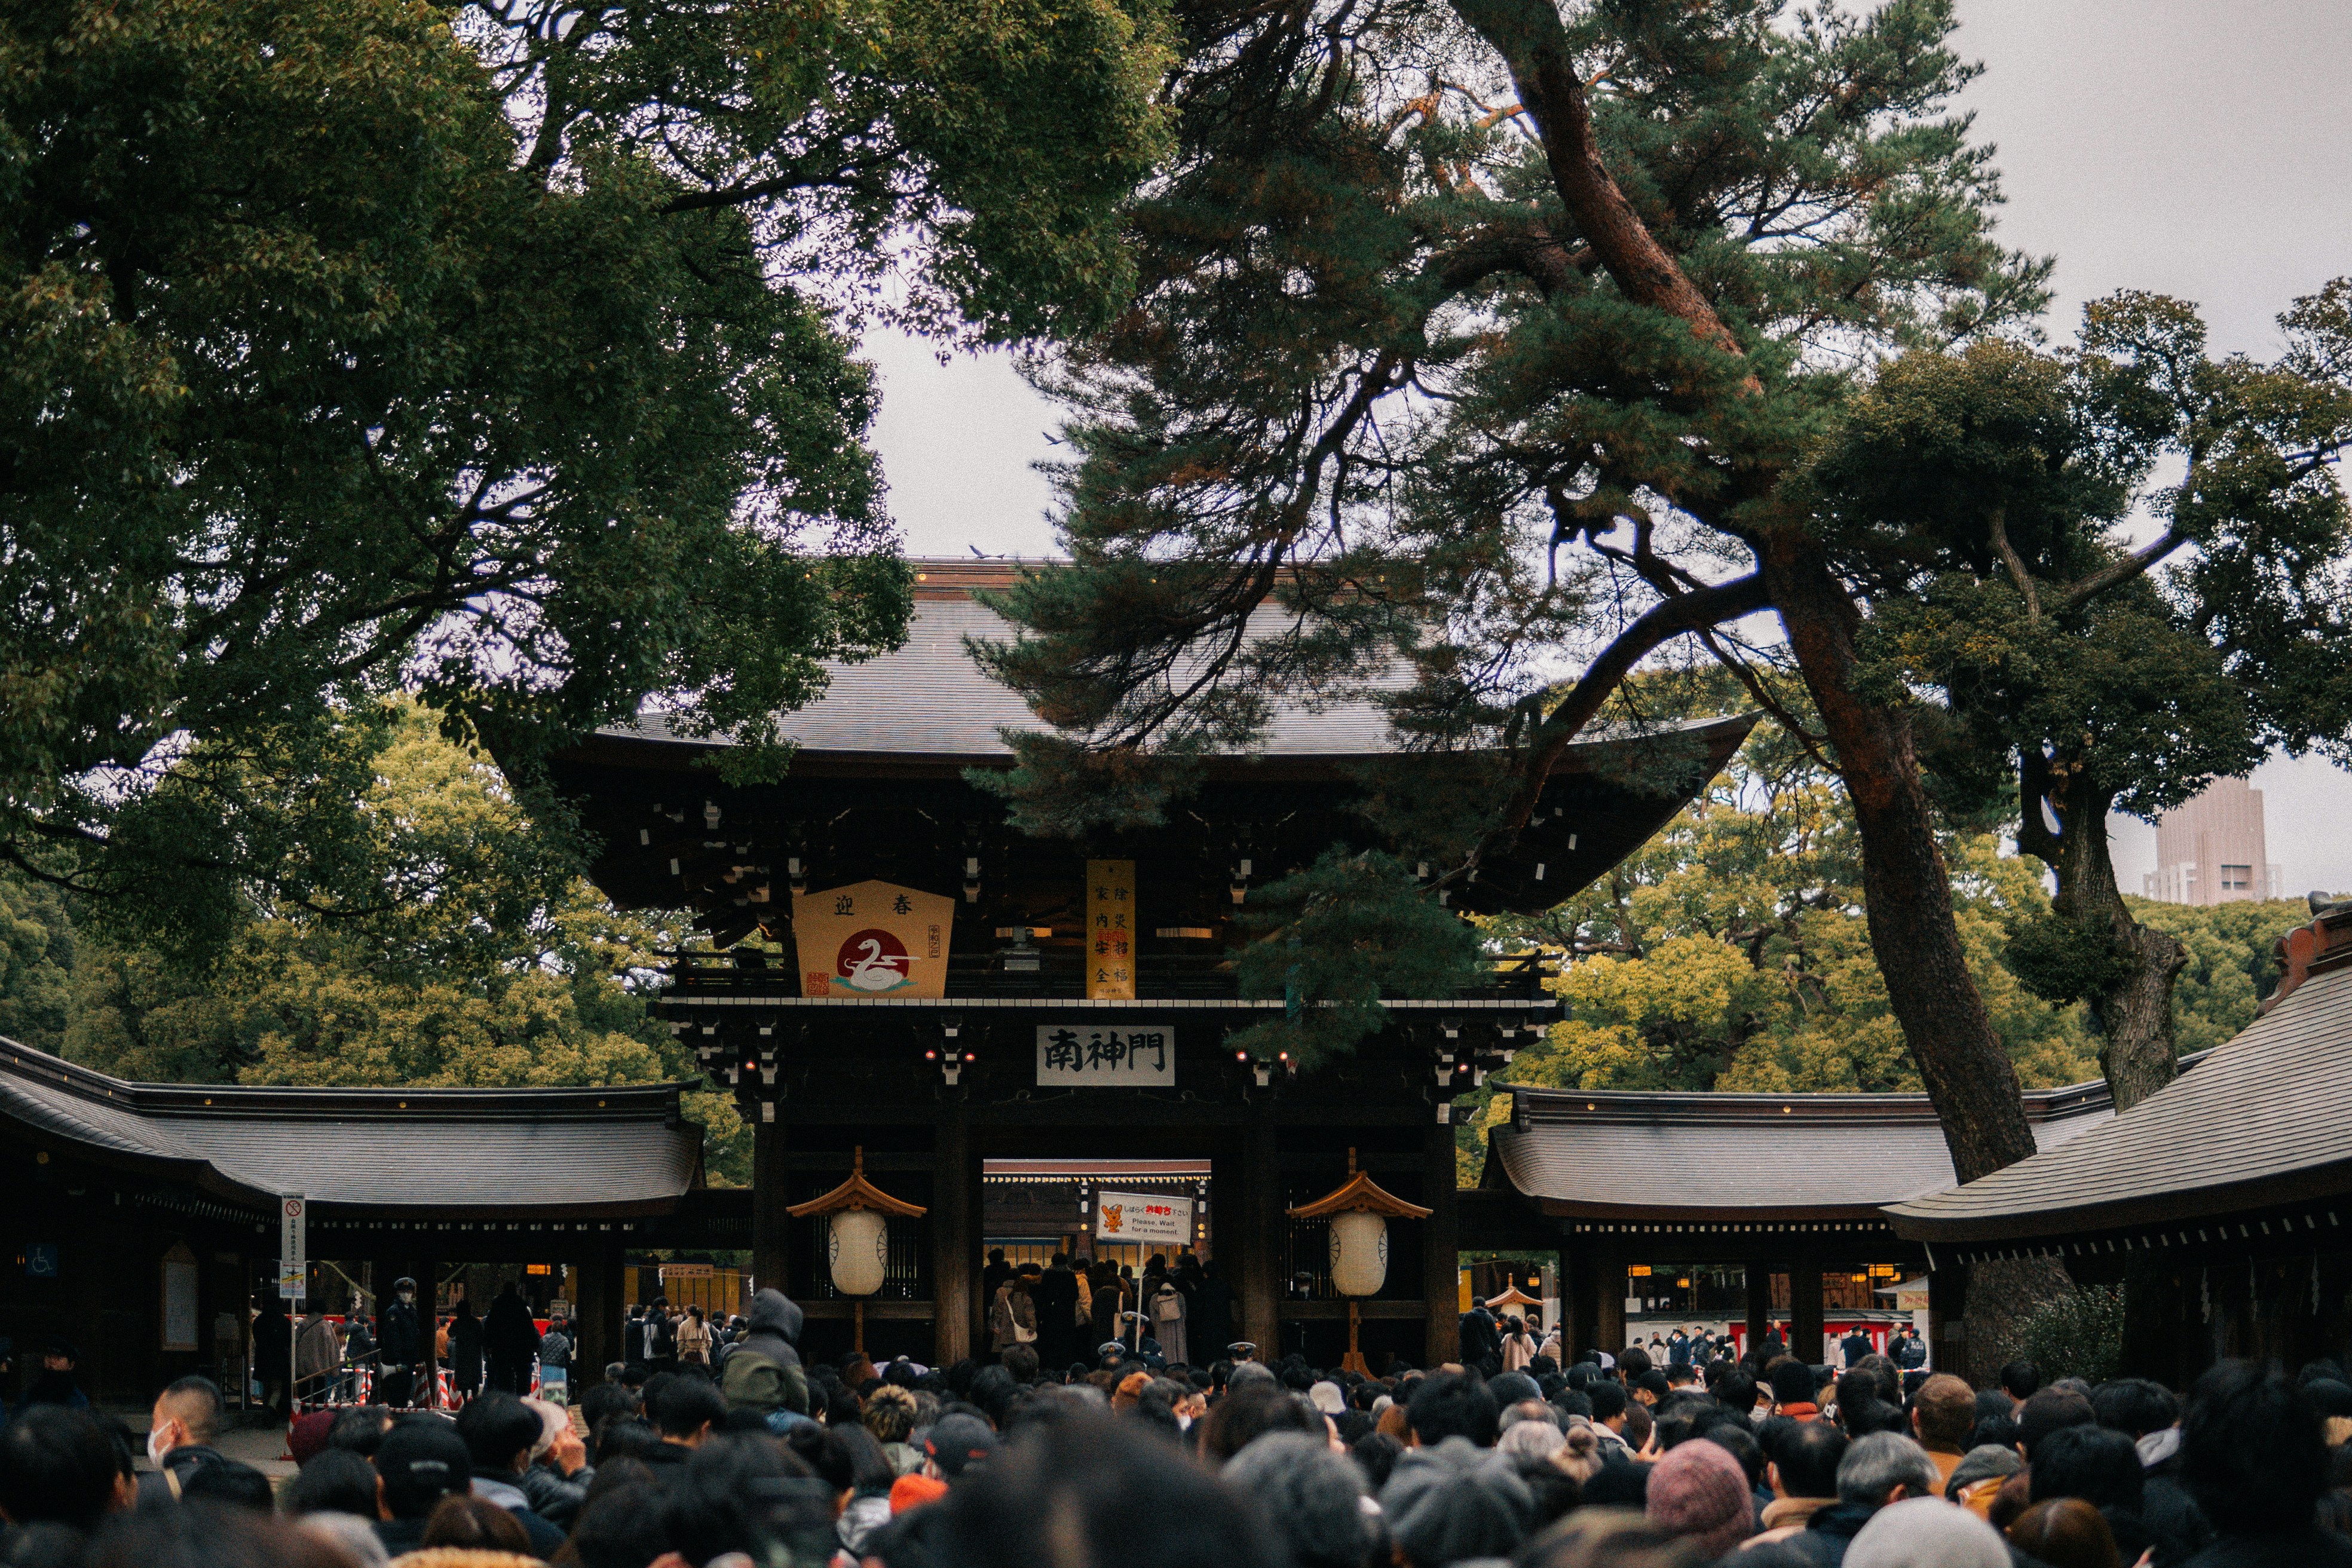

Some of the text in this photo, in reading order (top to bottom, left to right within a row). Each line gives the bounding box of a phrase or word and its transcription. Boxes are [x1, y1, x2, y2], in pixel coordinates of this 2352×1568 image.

[834, 895, 912, 915] 迎春
[1095, 886, 1109, 982] 家内安全
[1114, 887, 1129, 982] 除災招福
[1044, 1028, 1166, 1072] 南神門
